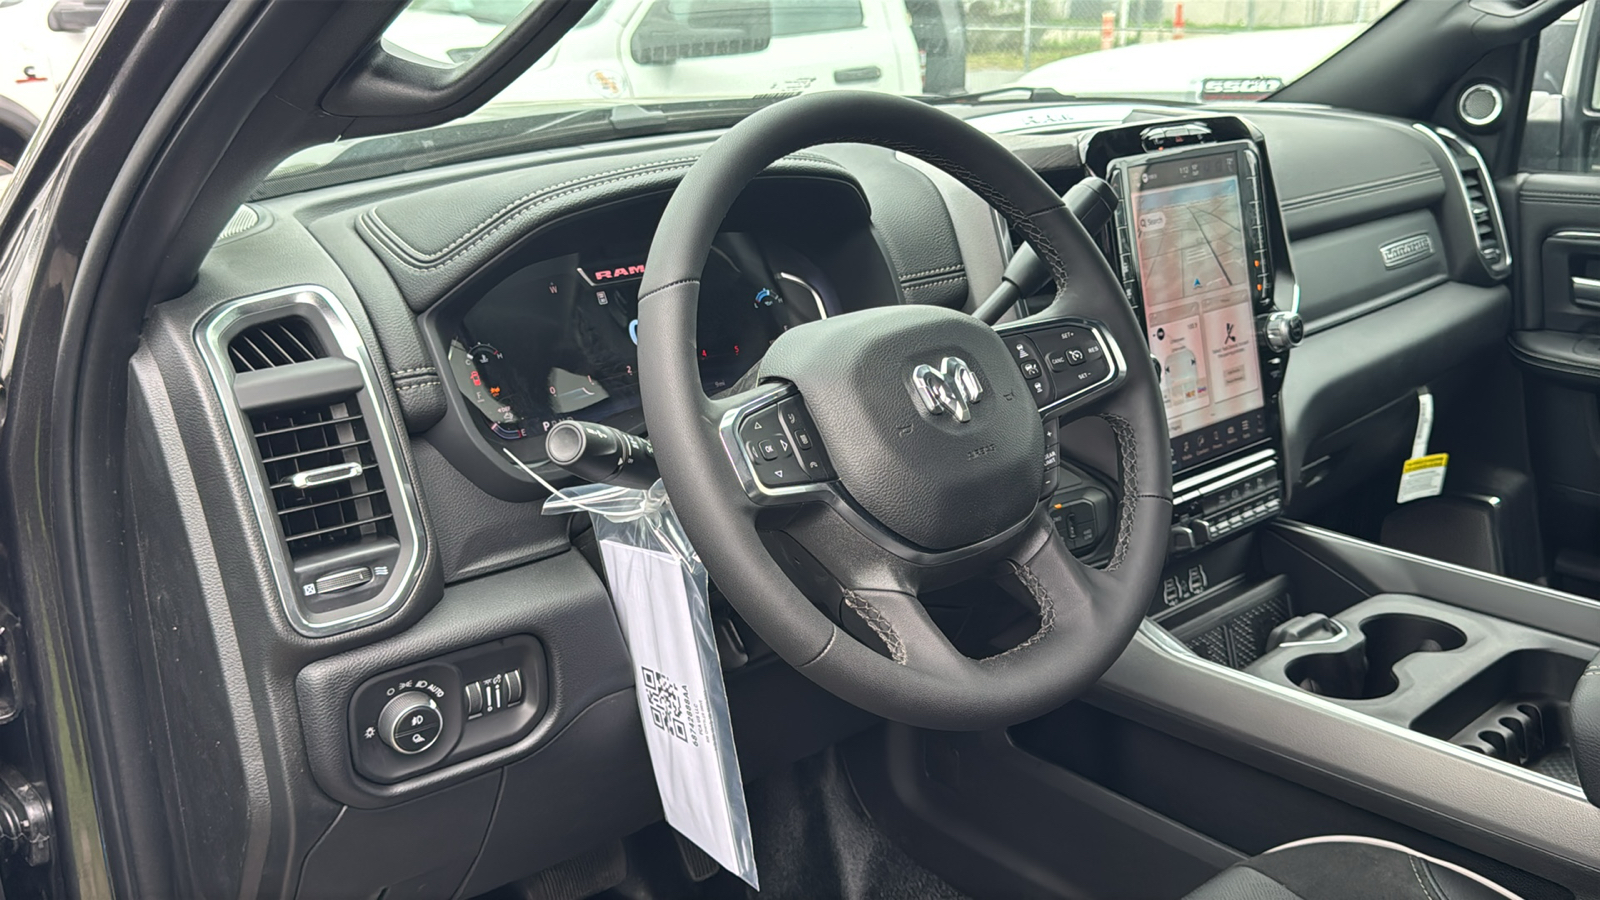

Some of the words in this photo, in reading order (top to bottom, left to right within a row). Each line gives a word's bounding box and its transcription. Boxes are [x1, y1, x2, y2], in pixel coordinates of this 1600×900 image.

[594, 264, 646, 280] RAM
[549, 285, 558, 294] W
[1087, 345, 1099, 354] RES
[1051, 356, 1065, 365] CANC
[542, 421, 550, 432] P
[764, 444, 774, 453] OK
[427, 683, 445, 698] AUTO
